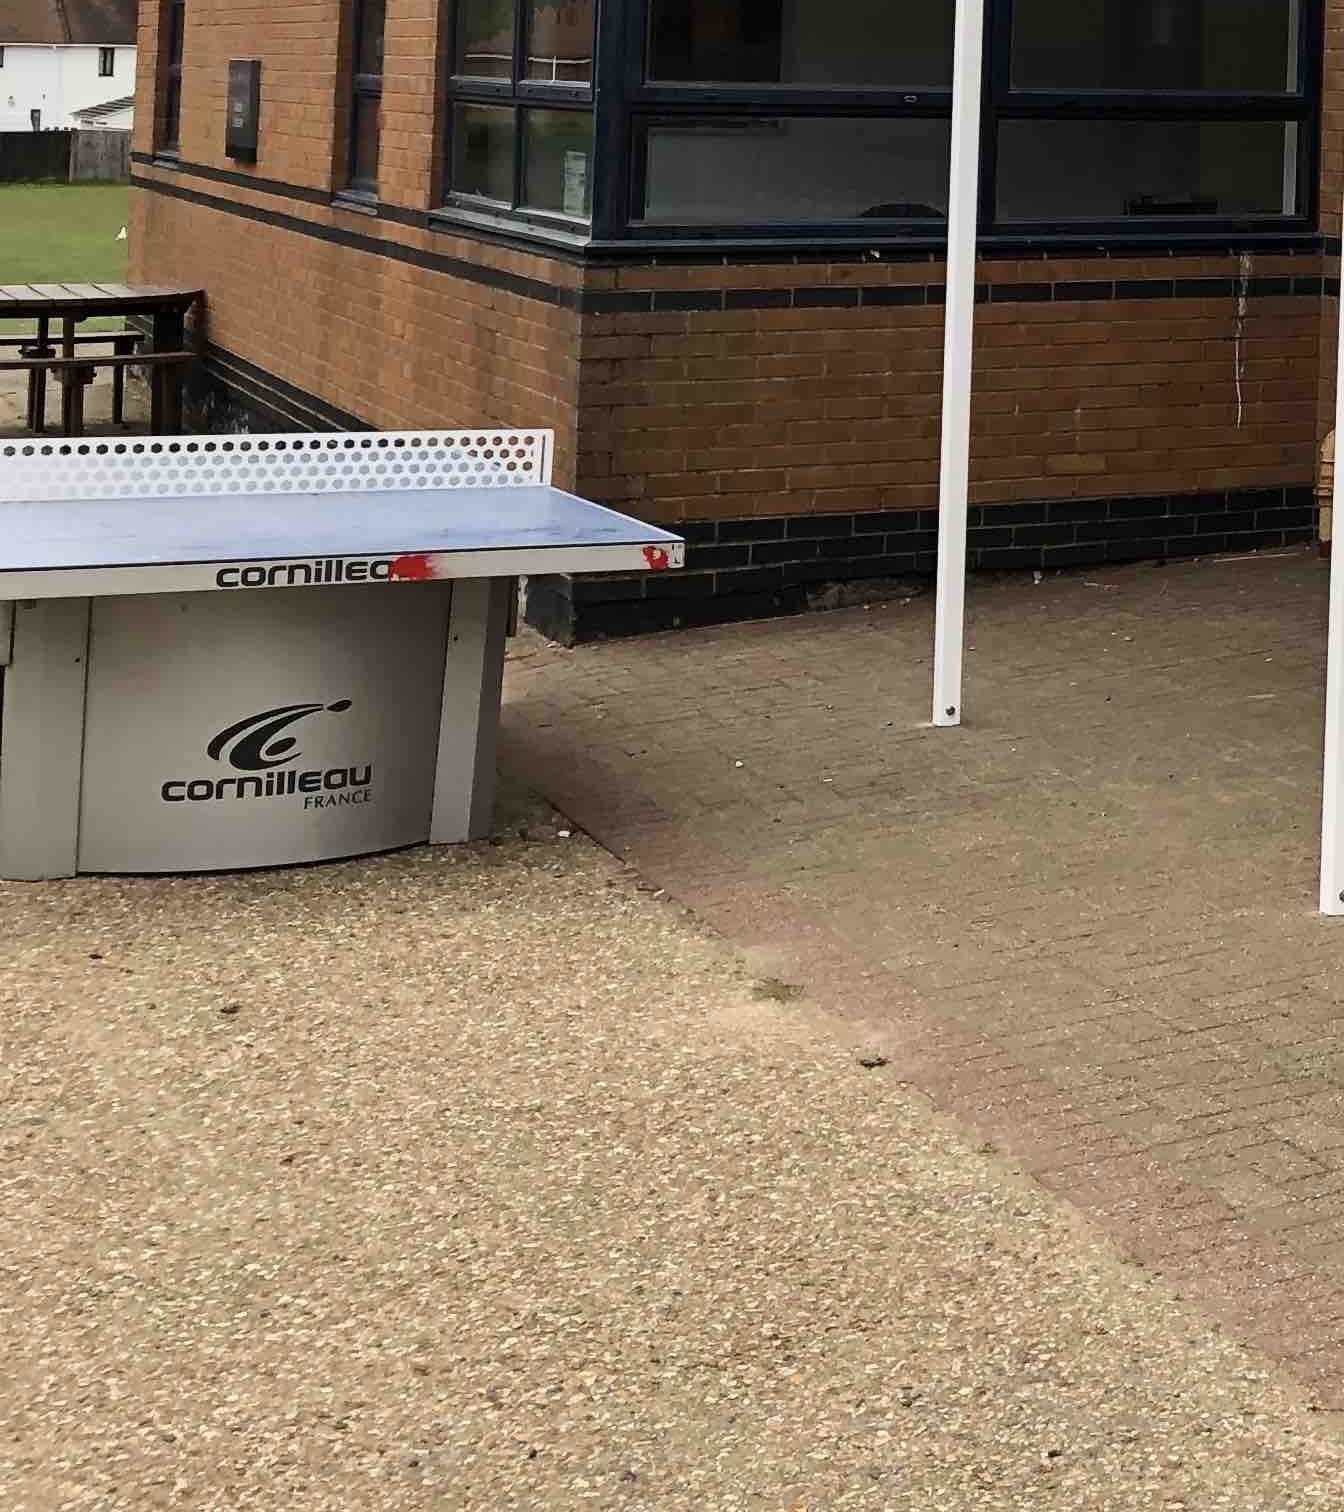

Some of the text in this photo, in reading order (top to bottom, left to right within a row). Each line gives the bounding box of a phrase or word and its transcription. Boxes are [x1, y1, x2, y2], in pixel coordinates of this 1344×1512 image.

[216, 559, 402, 588] cornillea
[161, 765, 372, 802] cornilleau
[303, 789, 373, 810] FRANCE
